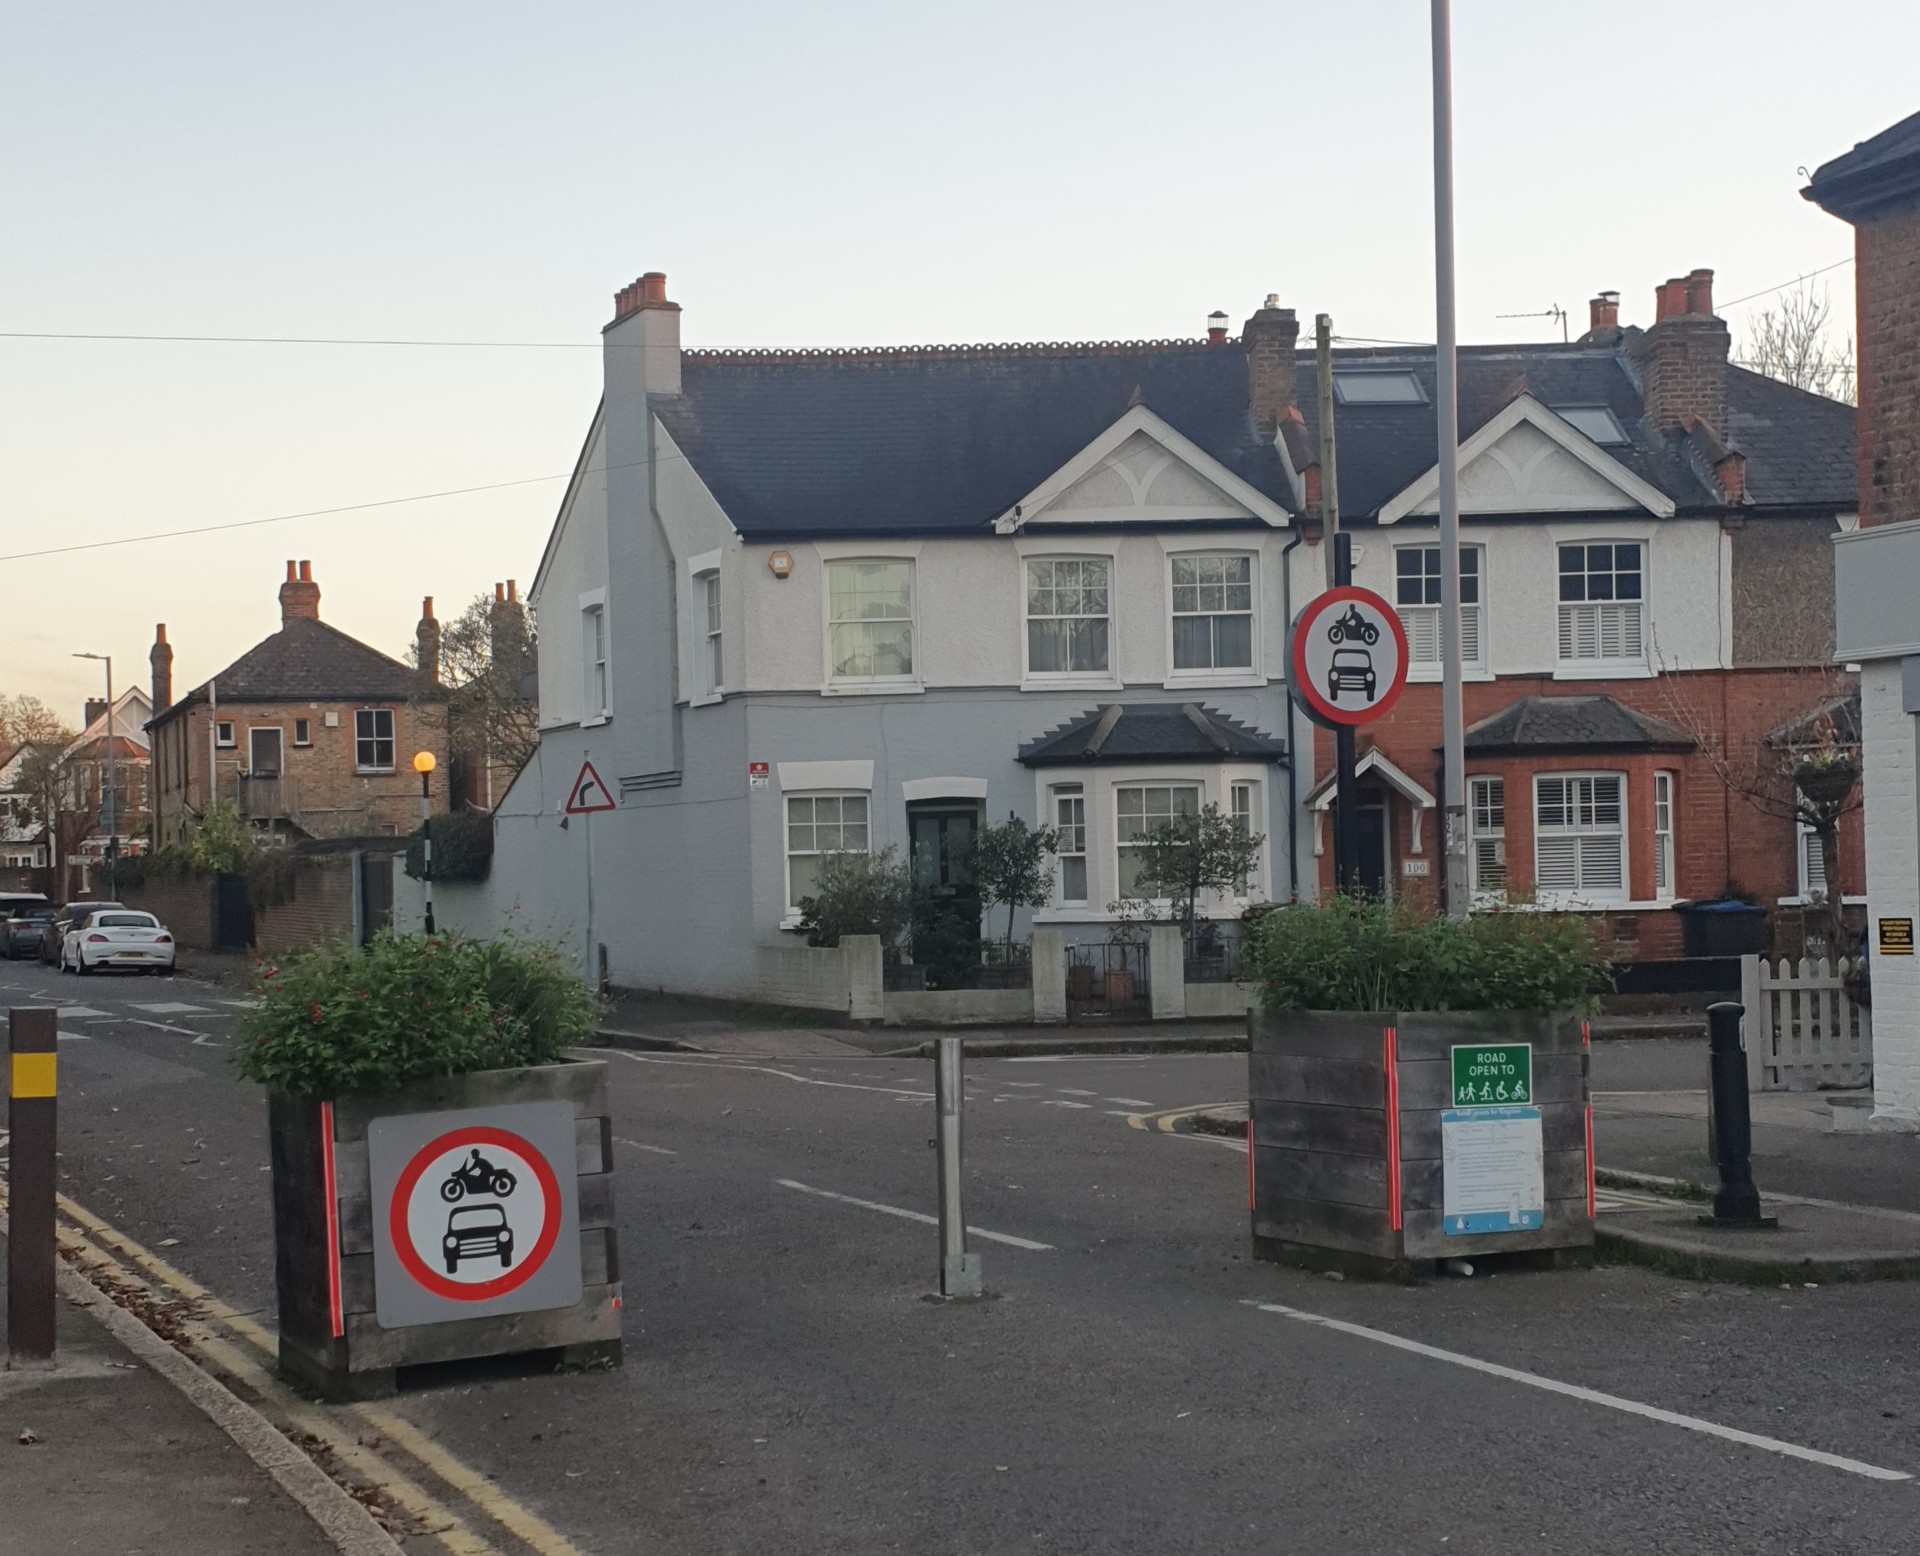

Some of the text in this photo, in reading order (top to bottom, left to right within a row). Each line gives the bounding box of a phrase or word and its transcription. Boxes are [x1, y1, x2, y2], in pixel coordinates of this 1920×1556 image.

[1407, 863, 1426, 873] 100
[1477, 1052, 1507, 1064] ROAD
[1469, 1064, 1515, 1076] OPEN TO
